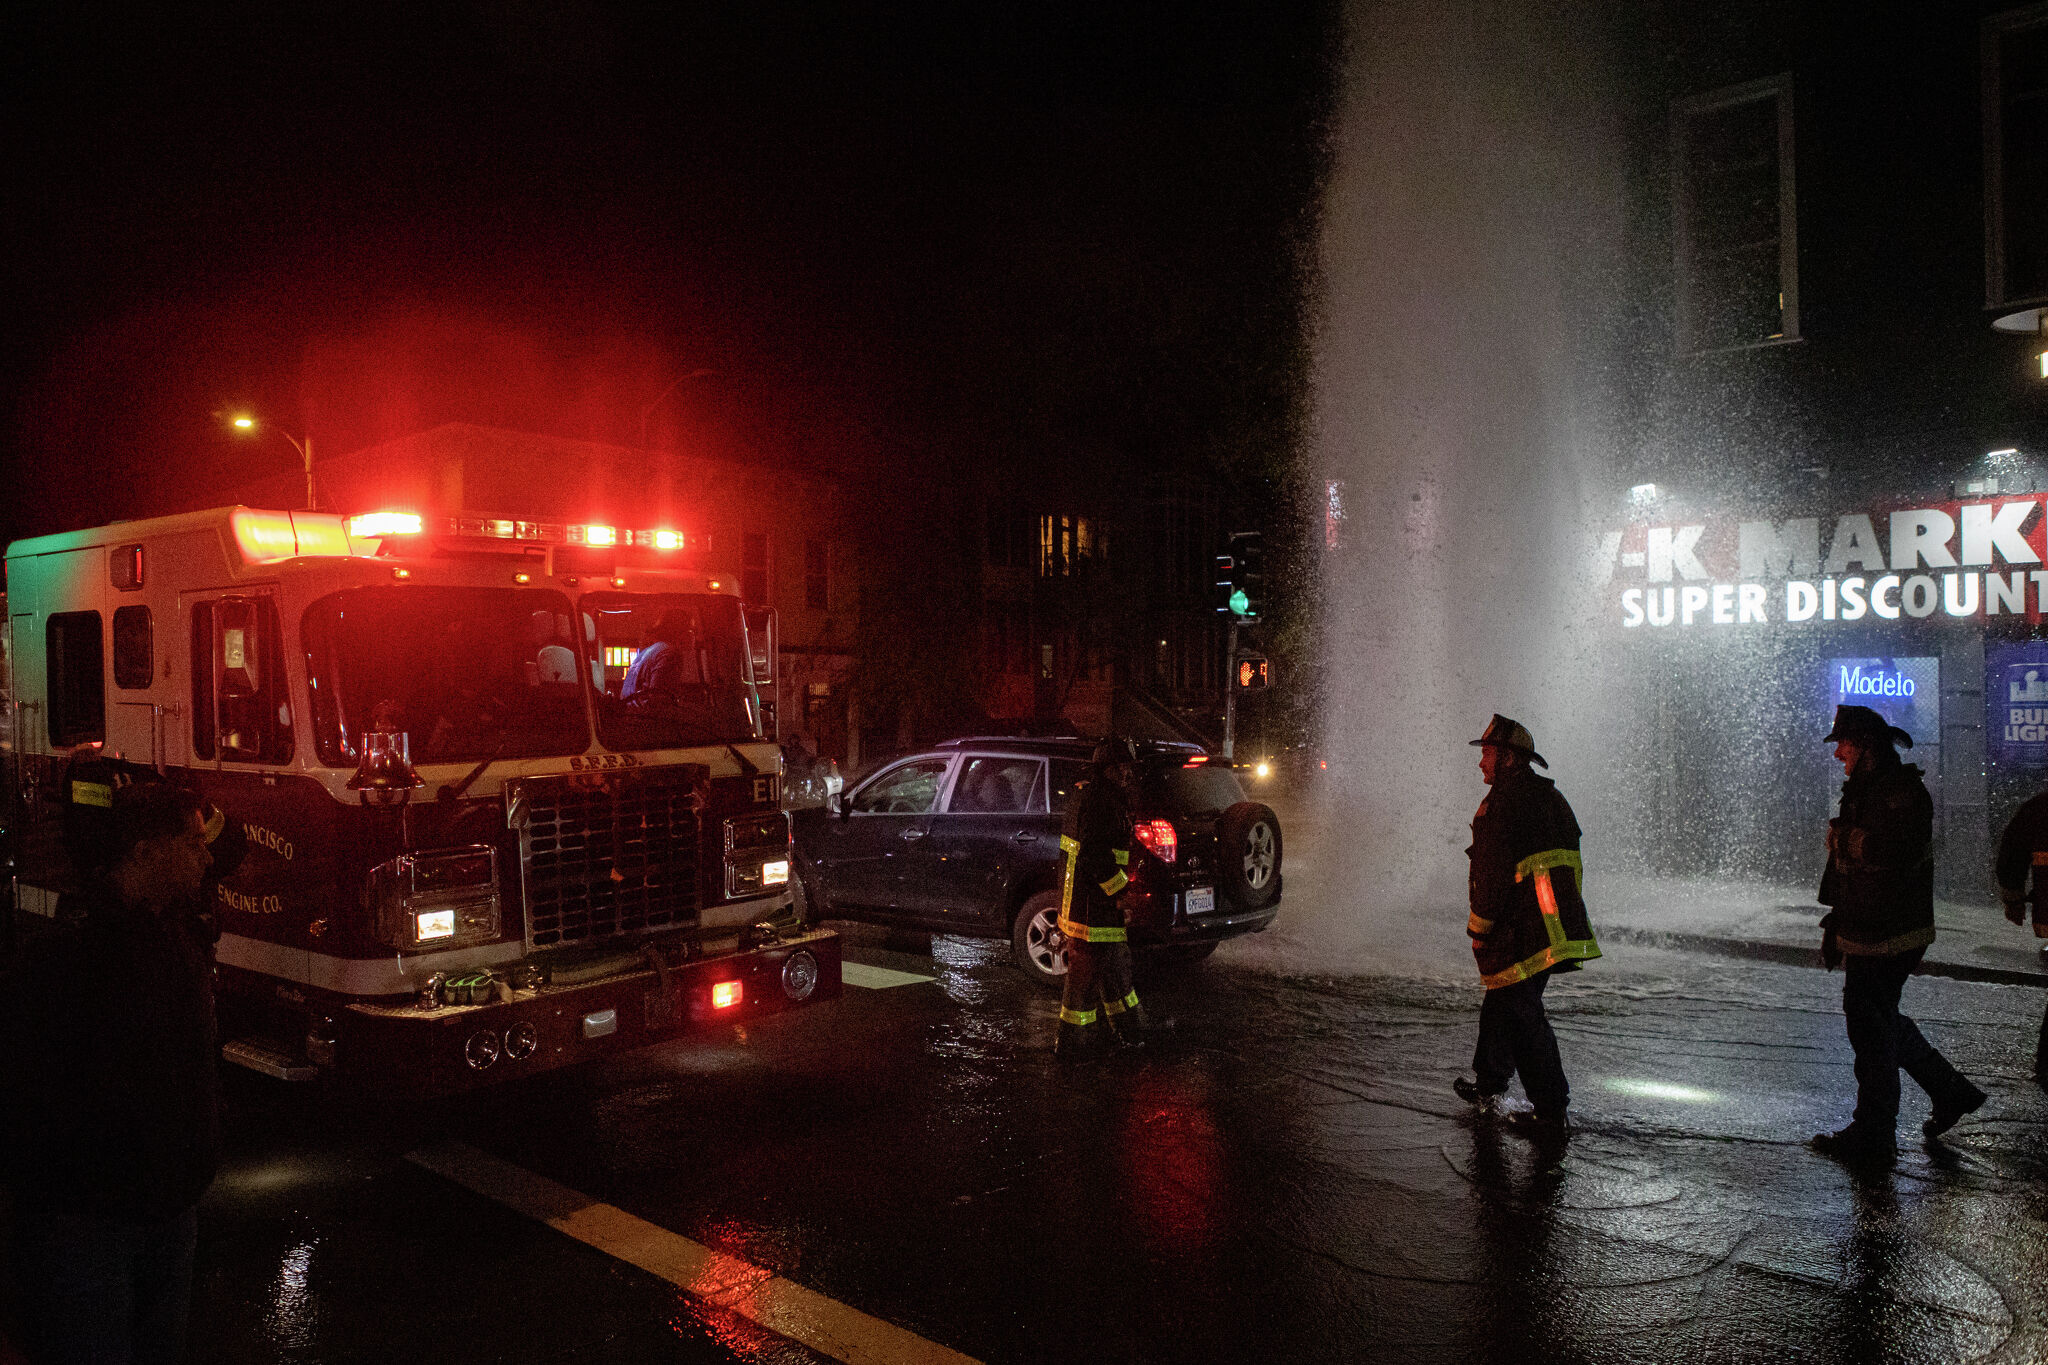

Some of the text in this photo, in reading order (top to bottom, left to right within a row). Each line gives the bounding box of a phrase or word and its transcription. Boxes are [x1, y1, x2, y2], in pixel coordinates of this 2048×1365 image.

[1738, 500, 2048, 581] MARK
[1621, 570, 2048, 628] SUPER DISCOUNT
[1840, 665, 1915, 697] Modelo
[2010, 708, 2048, 725] BU
[217, 883, 259, 914] ENGINE
